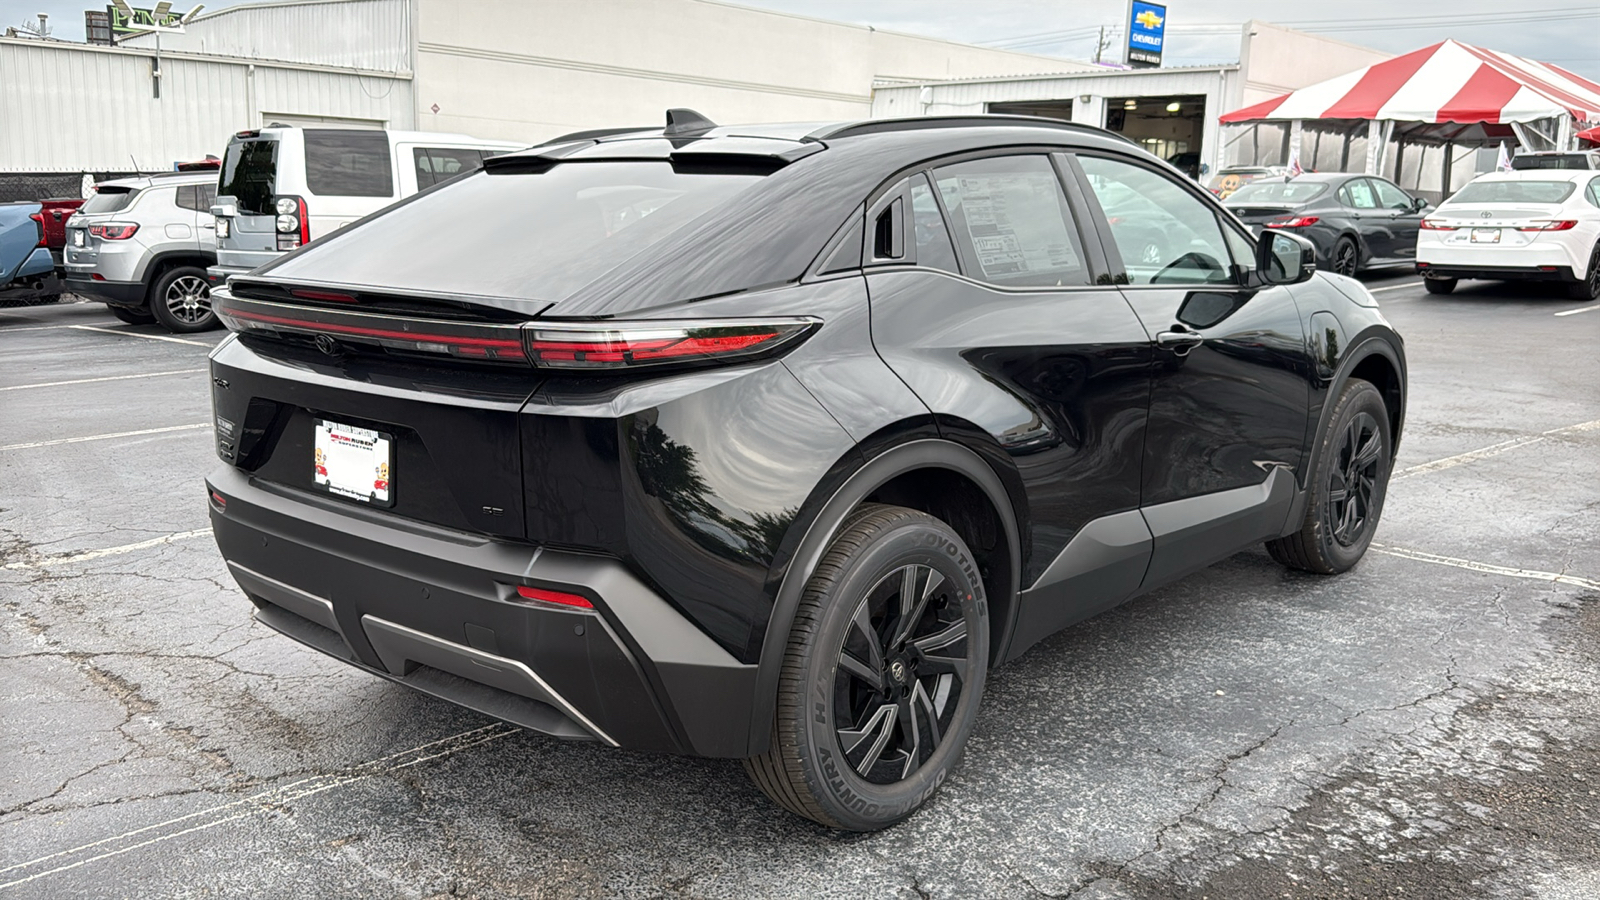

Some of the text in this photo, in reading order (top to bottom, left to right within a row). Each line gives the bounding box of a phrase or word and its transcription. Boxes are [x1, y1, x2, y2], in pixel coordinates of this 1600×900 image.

[1132, 34, 1161, 45] CHEVROLET
[1130, 53, 1160, 63] MILTON RUBEN
[330, 433, 374, 446] MILTON RUBEN
[957, 552, 987, 617] TIRES
[818, 747, 888, 819] COUNTRY
